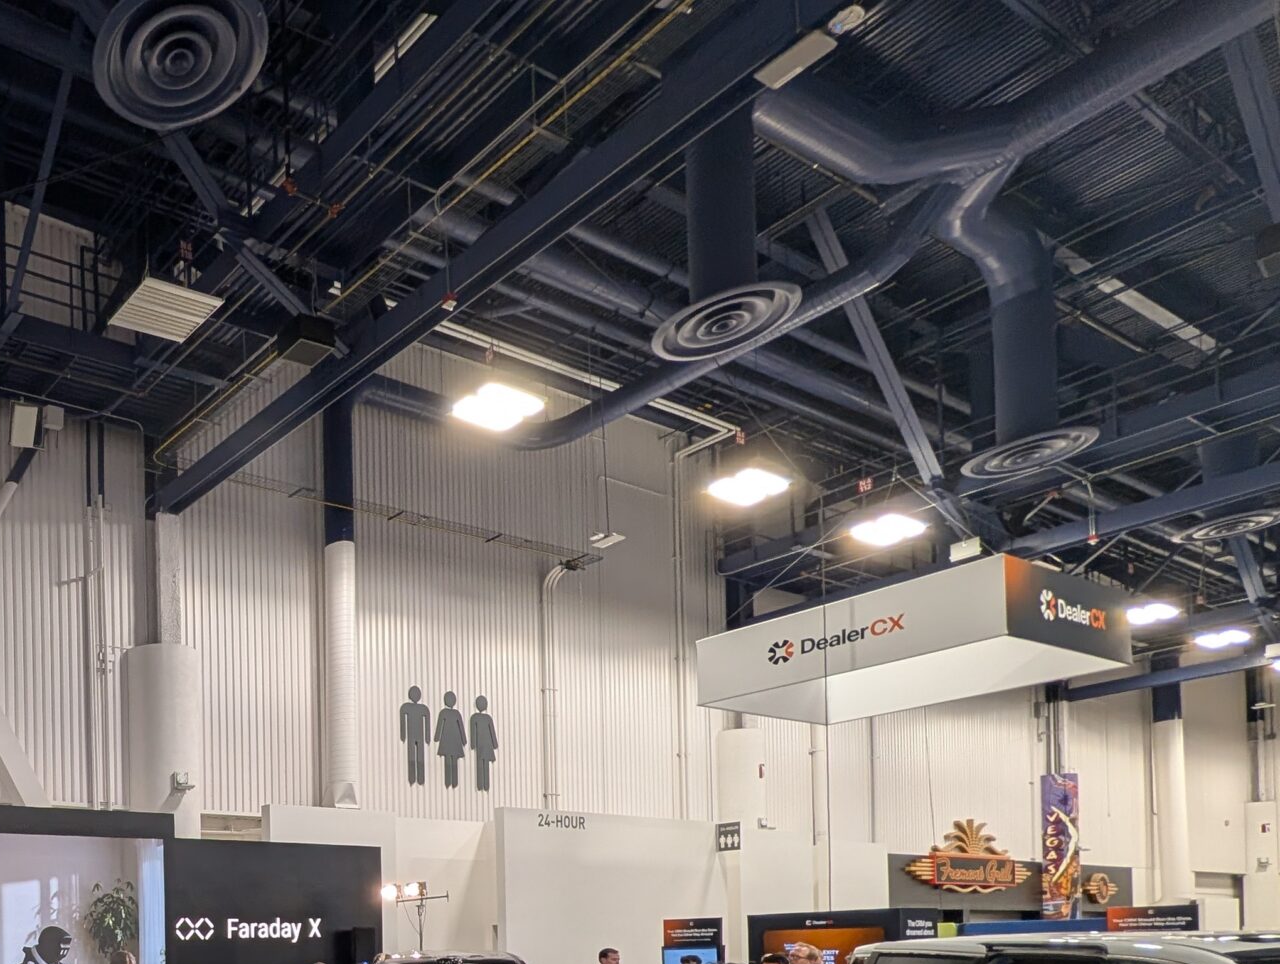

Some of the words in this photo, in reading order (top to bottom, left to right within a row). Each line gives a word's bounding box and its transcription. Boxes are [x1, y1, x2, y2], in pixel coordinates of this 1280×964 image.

[1057, 600, 1106, 630] DealerCX
[800, 613, 906, 655] DealerCX
[538, 814, 586, 830] 24-HOUR
[1046, 812, 1059, 874] VEGAS
[226, 917, 302, 943] Faraday
[308, 918, 322, 938] X
